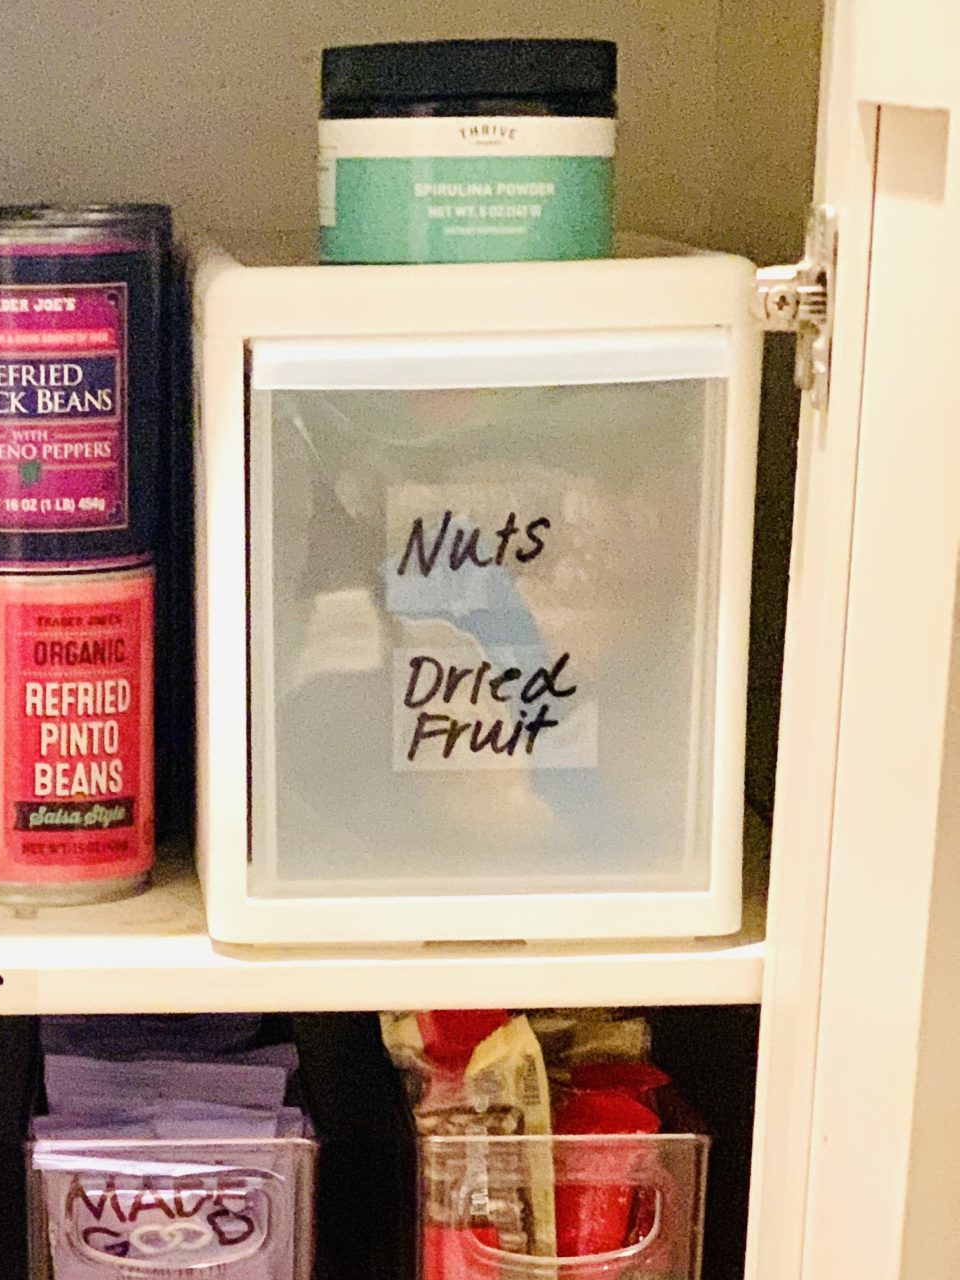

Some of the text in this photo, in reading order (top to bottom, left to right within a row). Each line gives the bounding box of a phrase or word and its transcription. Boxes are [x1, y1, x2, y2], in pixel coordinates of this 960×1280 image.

[37, 388, 113, 414] BEANS
[12, 429, 49, 442] WITH
[42, 441, 112, 460] PEPPERS
[396, 510, 551, 577] Nuts
[33, 637, 125, 666] ORGANIC
[25, 678, 131, 717] REFRIED
[403, 652, 577, 709] Dried
[40, 719, 120, 758] PINTO
[407, 704, 559, 761] Fruit
[34, 758, 123, 798] BEANS
[65, 1172, 249, 1223] MADE
[82, 1208, 256, 1258] GOOD
